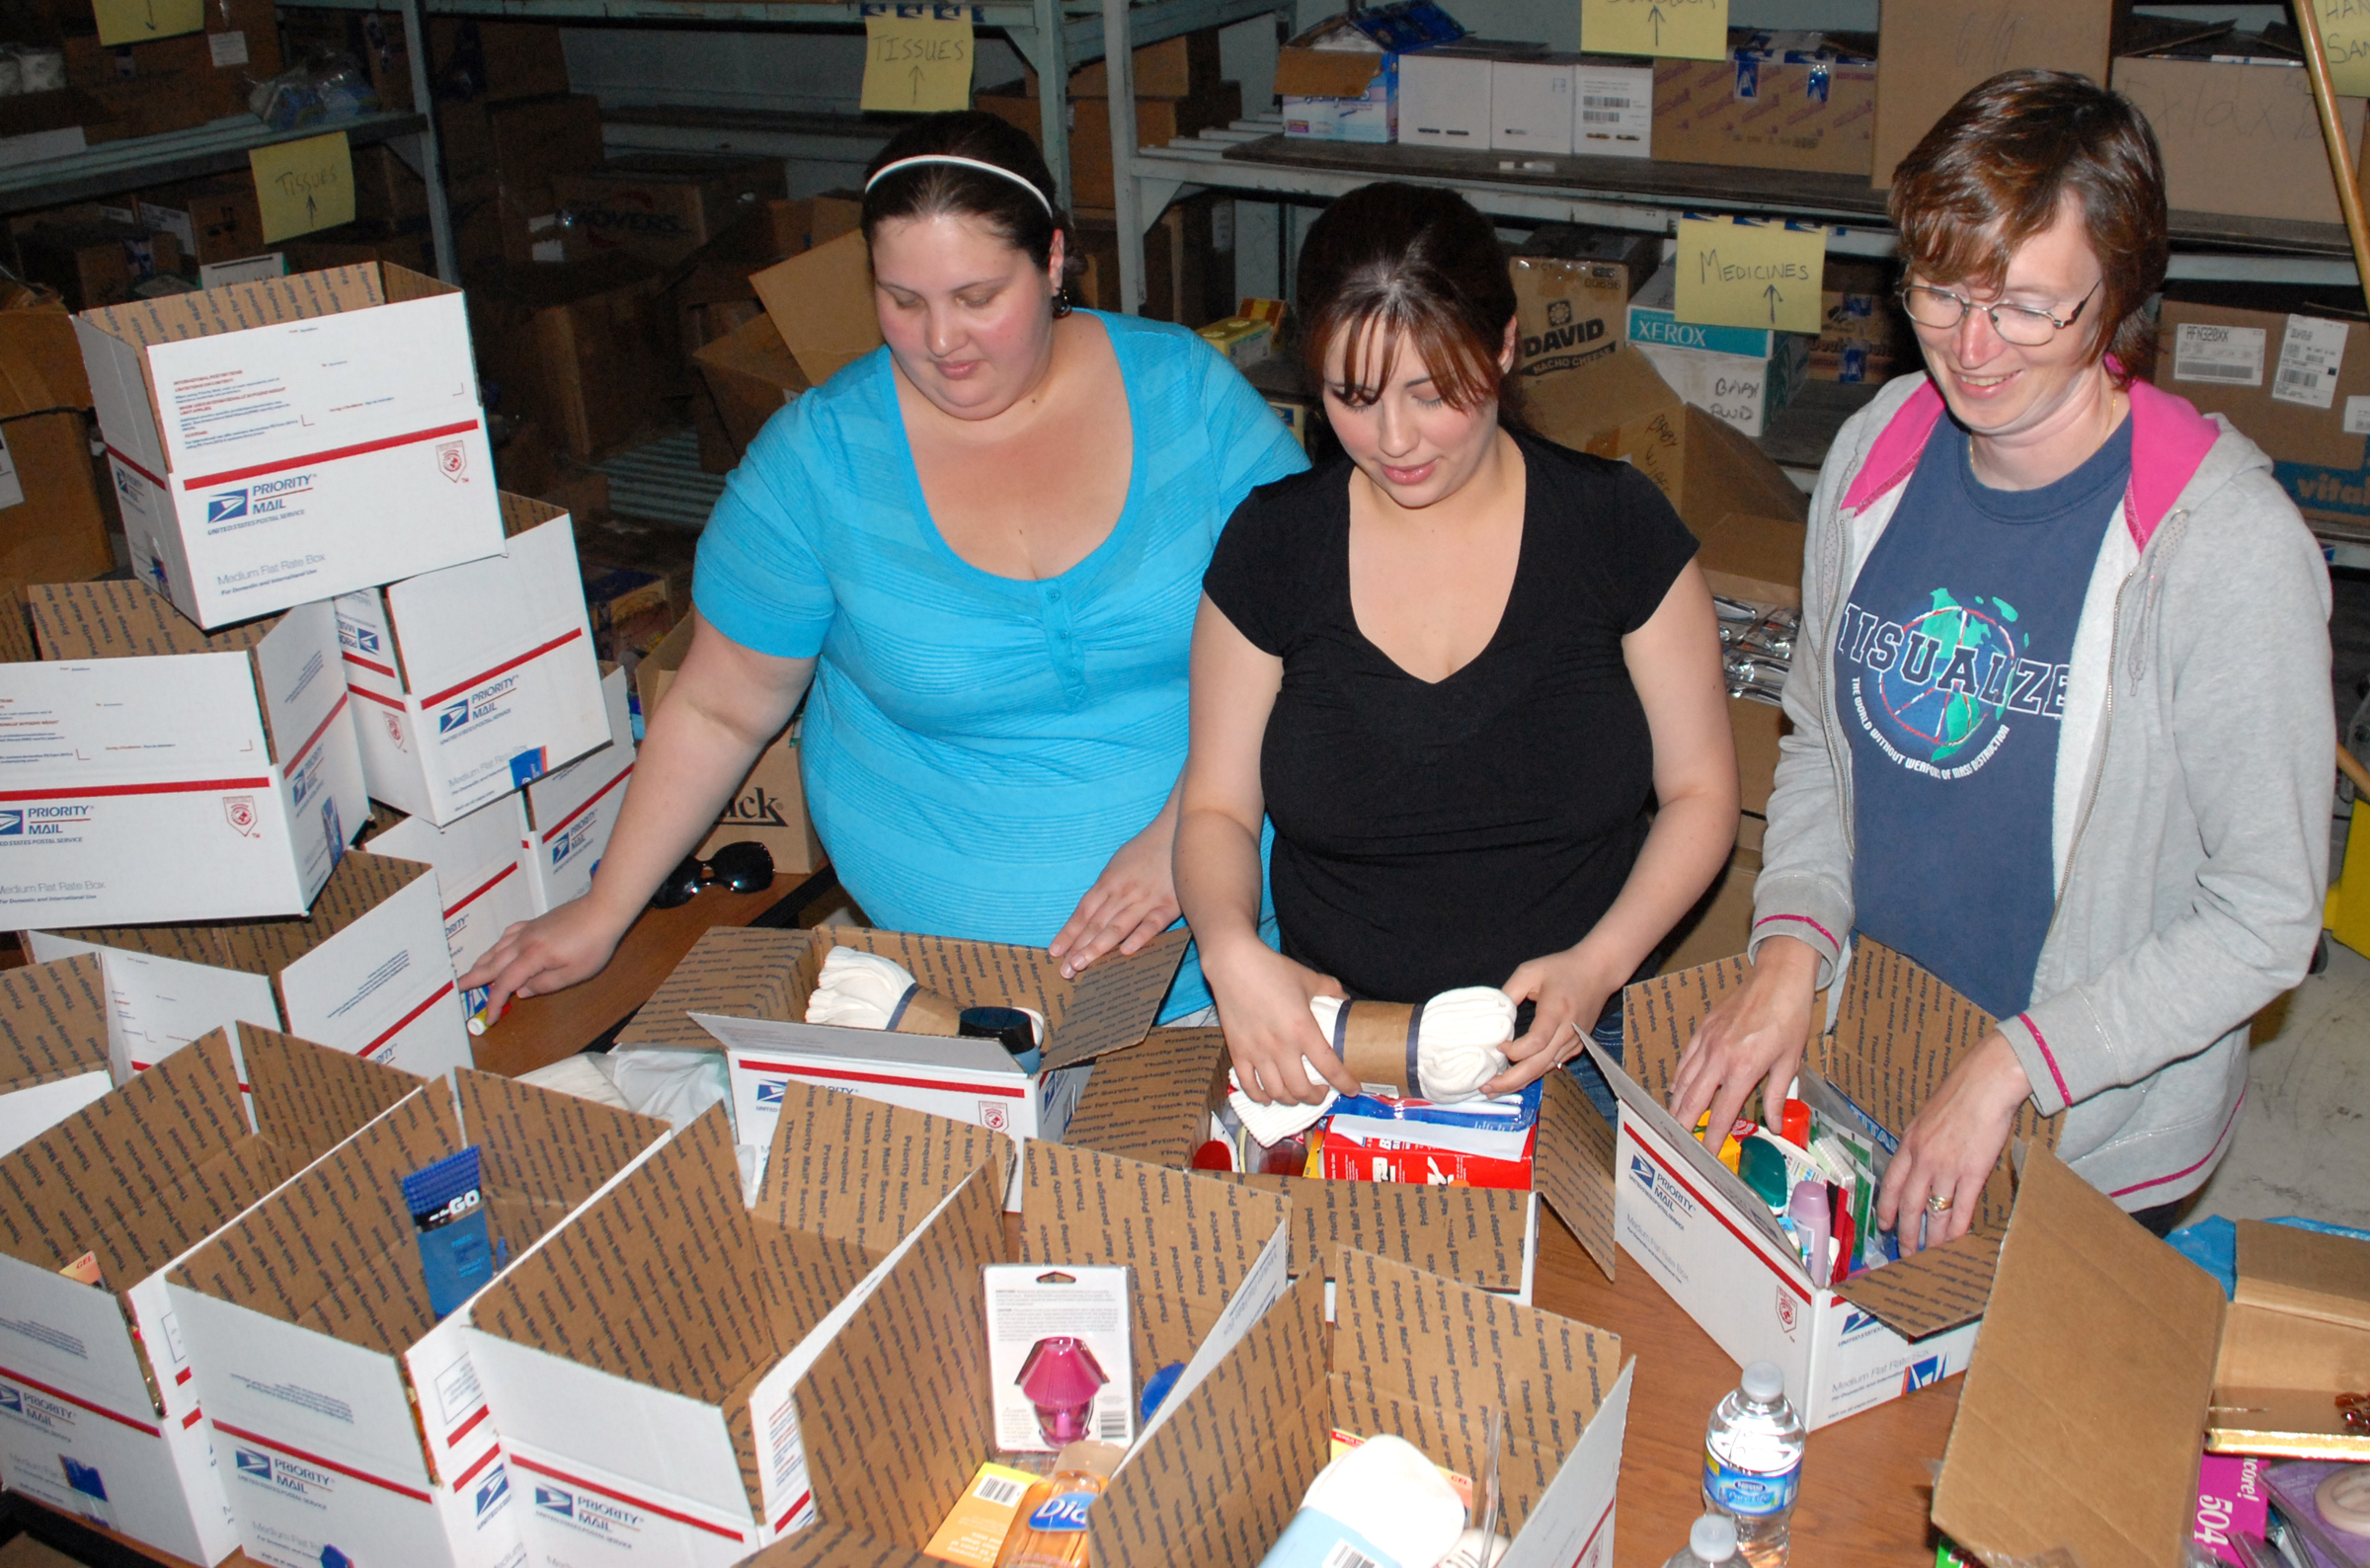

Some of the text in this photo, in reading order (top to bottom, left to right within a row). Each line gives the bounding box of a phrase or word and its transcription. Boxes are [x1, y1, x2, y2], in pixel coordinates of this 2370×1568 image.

[873, 36, 965, 62] TISSUES
[276, 164, 338, 196] TISSUES
[1700, 249, 1809, 284] MEDICINES
[1523, 318, 1606, 358] DAVID
[1637, 320, 1707, 348] XEROX
[1533, 348, 1613, 373] NACHO CHEESE
[252, 474, 312, 497] PRIORITY
[252, 498, 286, 515] MAIL
[216, 552, 326, 587] Medium Flat Rate Box
[471, 676, 514, 704] PRIORITY
[1852, 677, 1863, 696] THE
[472, 702, 498, 721] MAIL
[1854, 698, 1872, 731] WORLD
[1869, 729, 1907, 765] WITHOUT
[1973, 723, 2011, 770] DESTRUCTION
[1941, 768, 1952, 780] OF
[28, 805, 90, 819] PRIORITY
[28, 823, 64, 835] MAIL
[38, 882, 57, 893] Flat
[58, 881, 84, 892] Rate
[84, 880, 106, 890] Box
[785, 1120, 795, 1155] Thank
[839, 1097, 853, 1195] postage required
[864, 1111, 874, 1146] Thank
[798, 1112, 815, 1231] Priority Service
[820, 1144, 831, 1187] Priority
[900, 1136, 911, 1179] Priority
[921, 1137, 931, 1187] required
[1054, 1179, 1066, 1220] Priority
[1071, 1153, 1085, 1213] Thank you
[1138, 1172, 1149, 1214] Priority
[1654, 1187, 1675, 1213] MAIL
[1657, 1172, 1694, 1212] PRIORITY
[878, 1180, 888, 1223] Service
[1097, 1182, 1110, 1225] postage
[1124, 1217, 1136, 1259] Service
[1210, 1212, 1222, 1254] Service
[76, 1254, 94, 1270] GEL
[1170, 1246, 1185, 1294] required
[1192, 1254, 1206, 1296] Priority
[1343, 1250, 1355, 1286] Thank
[1391, 1280, 1404, 1323] Priority
[1376, 1321, 1388, 1364] Service
[1832, 1372, 1869, 1393] Medium
[1870, 1364, 1888, 1377] Flat
[24, 1392, 74, 1420] PRIORITY
[26, 1408, 55, 1428] MAIL
[275, 1457, 332, 1486] PRIORITY
[276, 1474, 308, 1495] MAIL
[578, 1494, 639, 1525] PRIORITY
[578, 1513, 613, 1533] MAIL
[2193, 1494, 2234, 1546] 504
